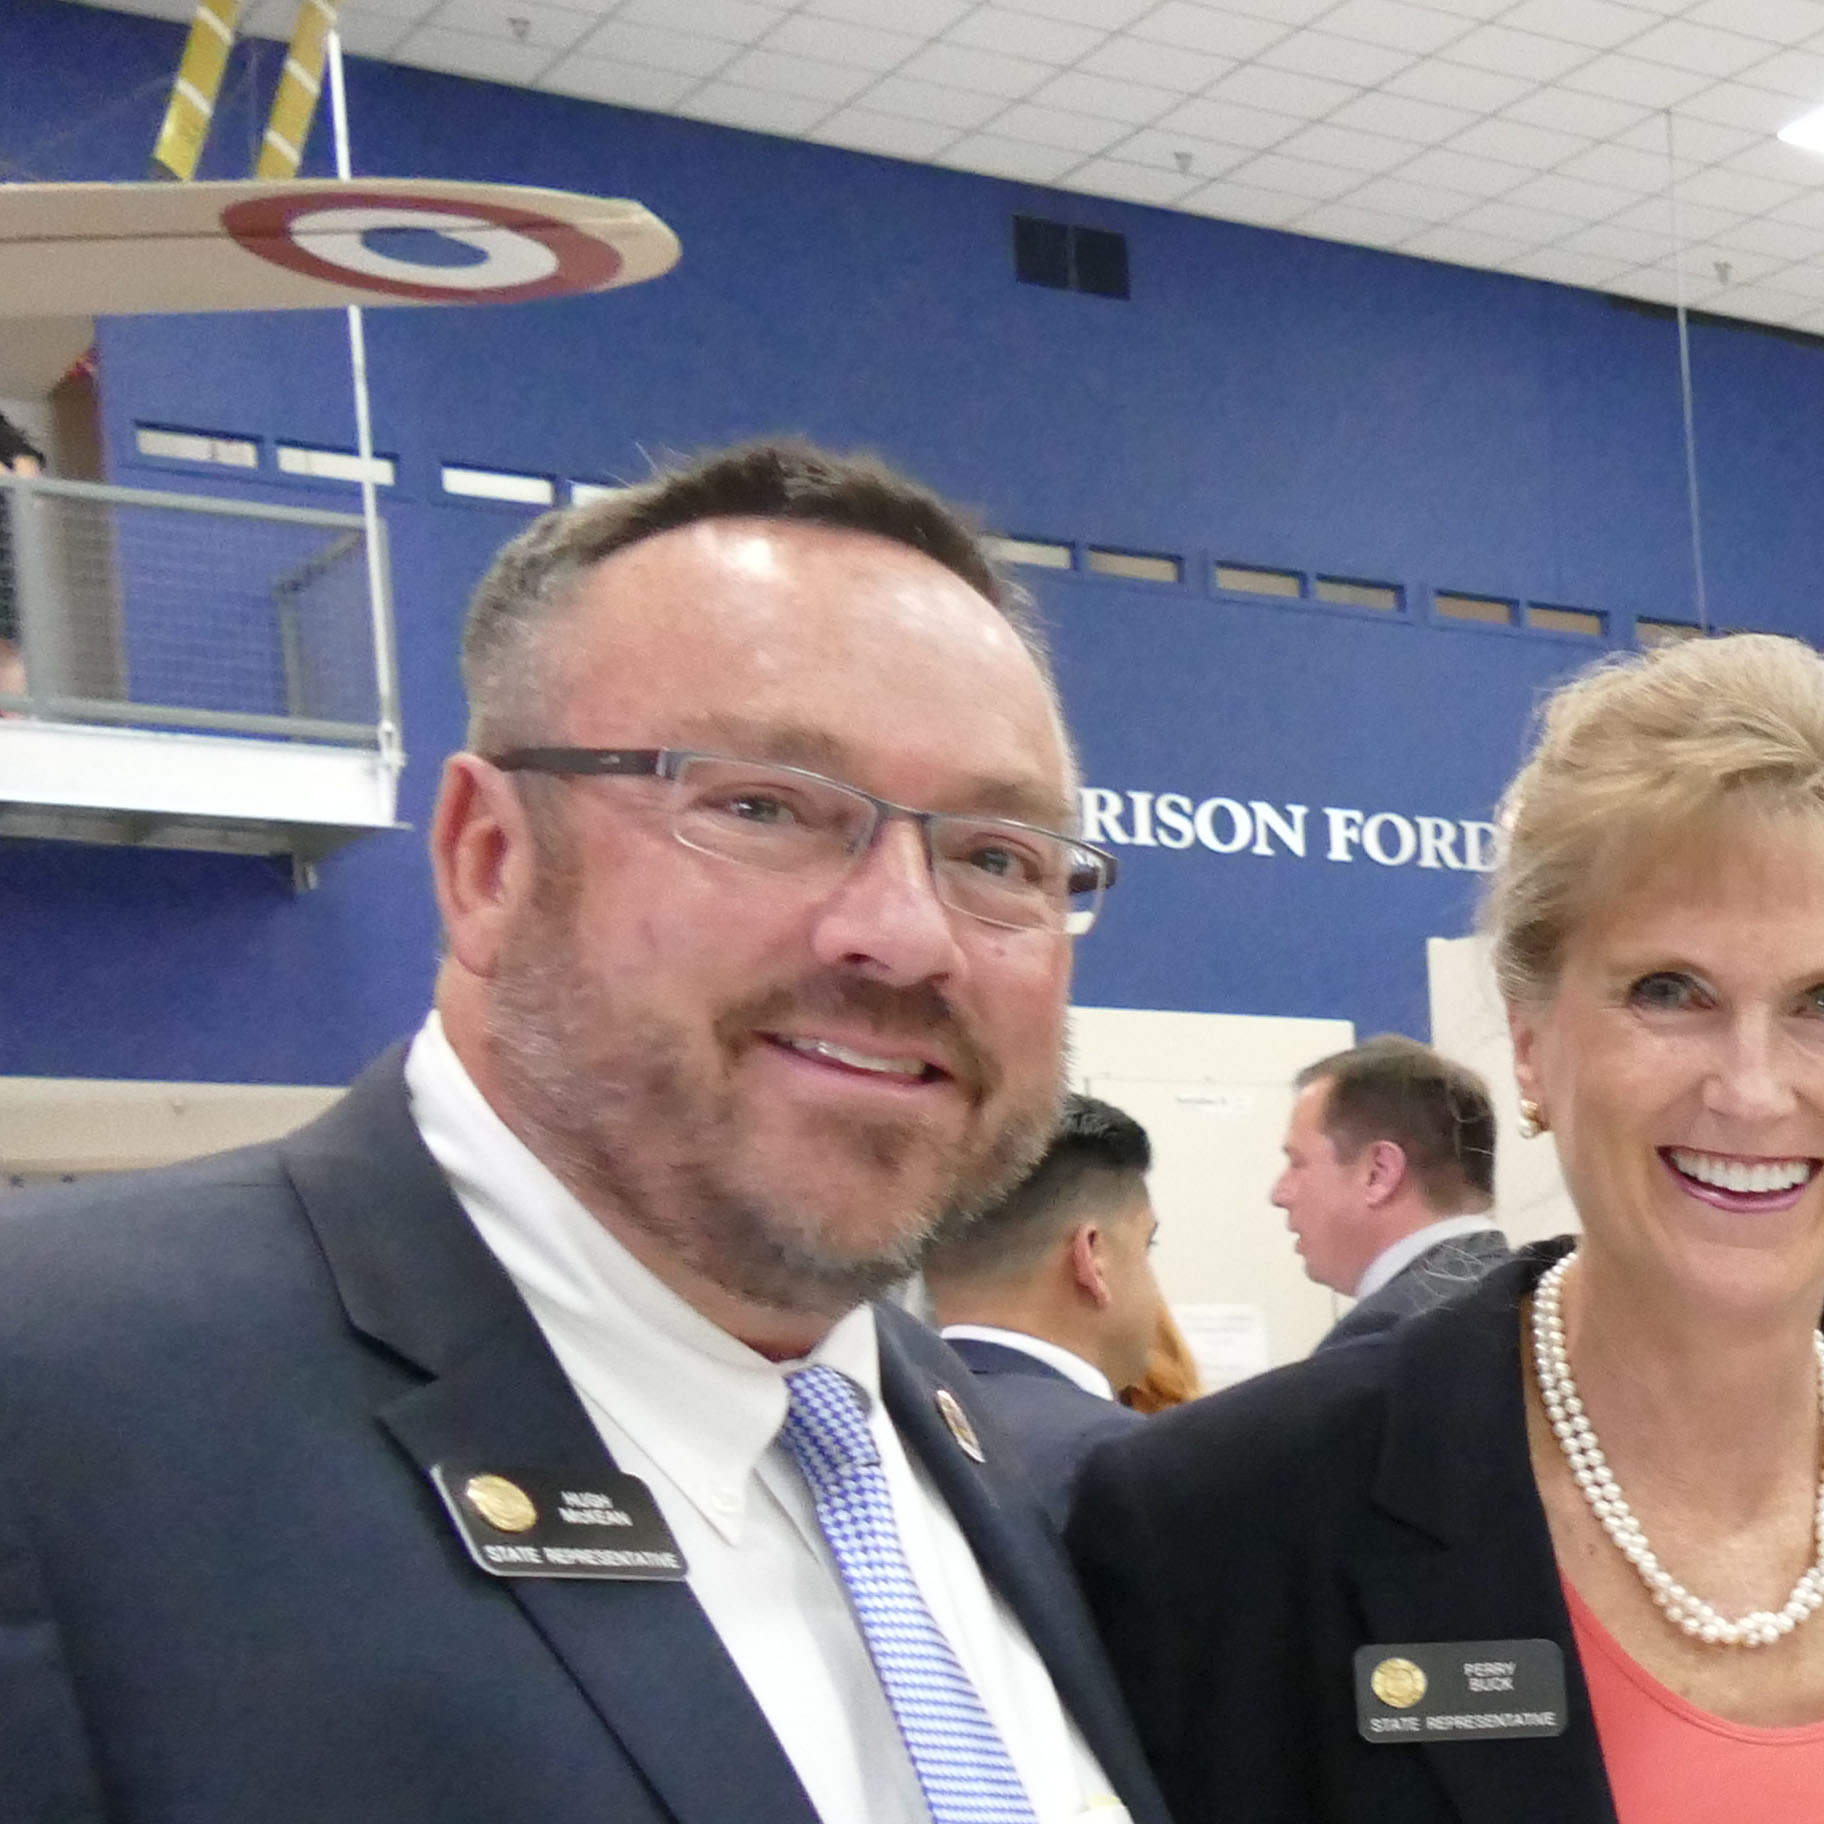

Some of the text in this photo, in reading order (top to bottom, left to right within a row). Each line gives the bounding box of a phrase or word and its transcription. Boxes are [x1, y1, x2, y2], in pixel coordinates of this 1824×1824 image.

[1077, 786, 1501, 873] RISON FORD
[483, 1546, 681, 1567] STATE REPRESENTATIVE
[1464, 1662, 1515, 1676] PERRY
[1469, 1677, 1514, 1691] BUCK
[1371, 1712, 1557, 1732] STATE REPRESENTATIVE
